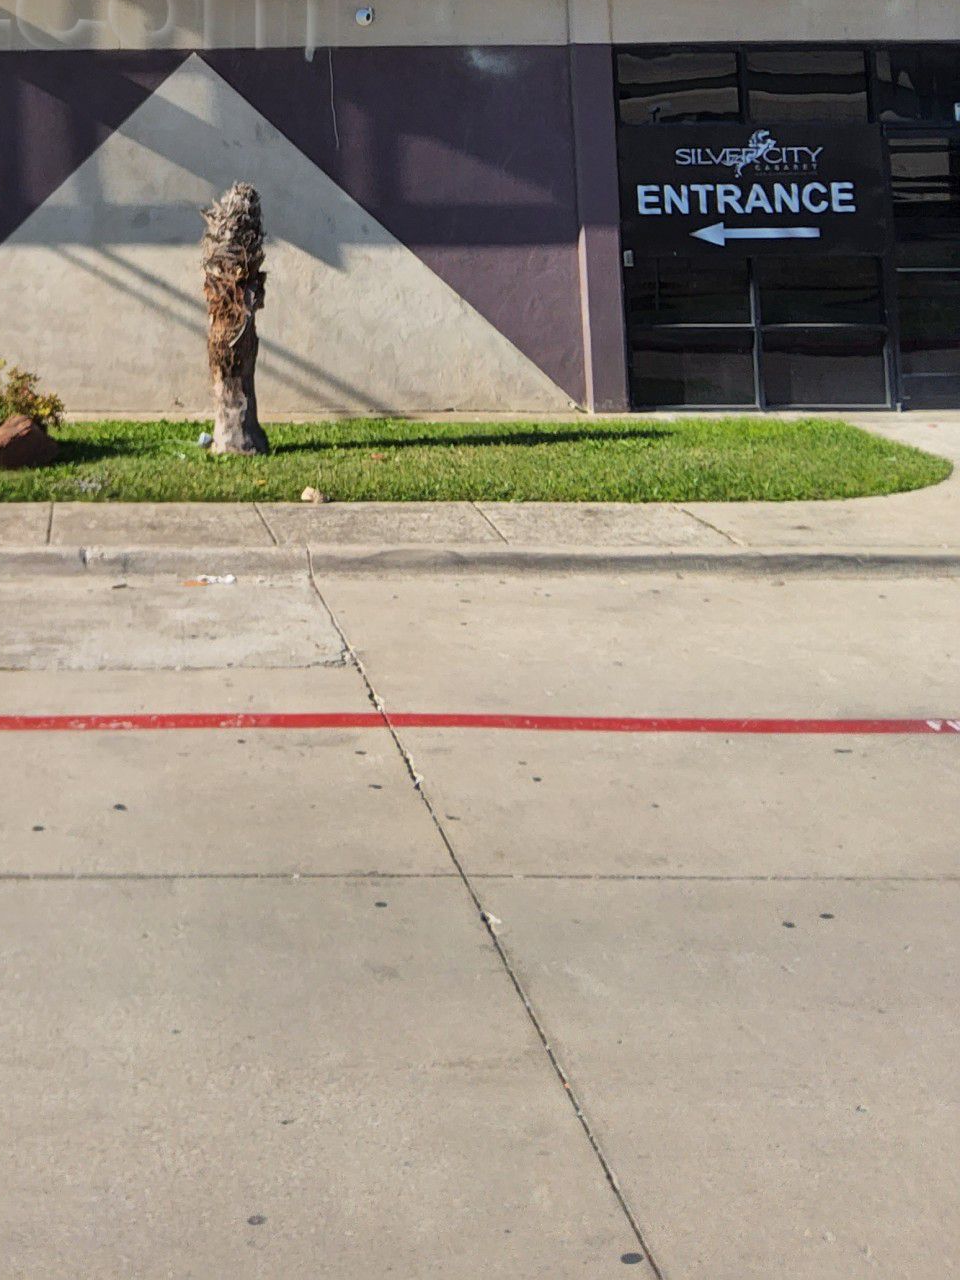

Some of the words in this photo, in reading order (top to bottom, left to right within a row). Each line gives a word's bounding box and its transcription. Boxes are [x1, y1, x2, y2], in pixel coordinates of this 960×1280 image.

[675, 147, 760, 165] SILVER
[762, 147, 823, 164] CITY
[754, 163, 818, 171] CABARET
[636, 181, 856, 216] ENTRANCE
